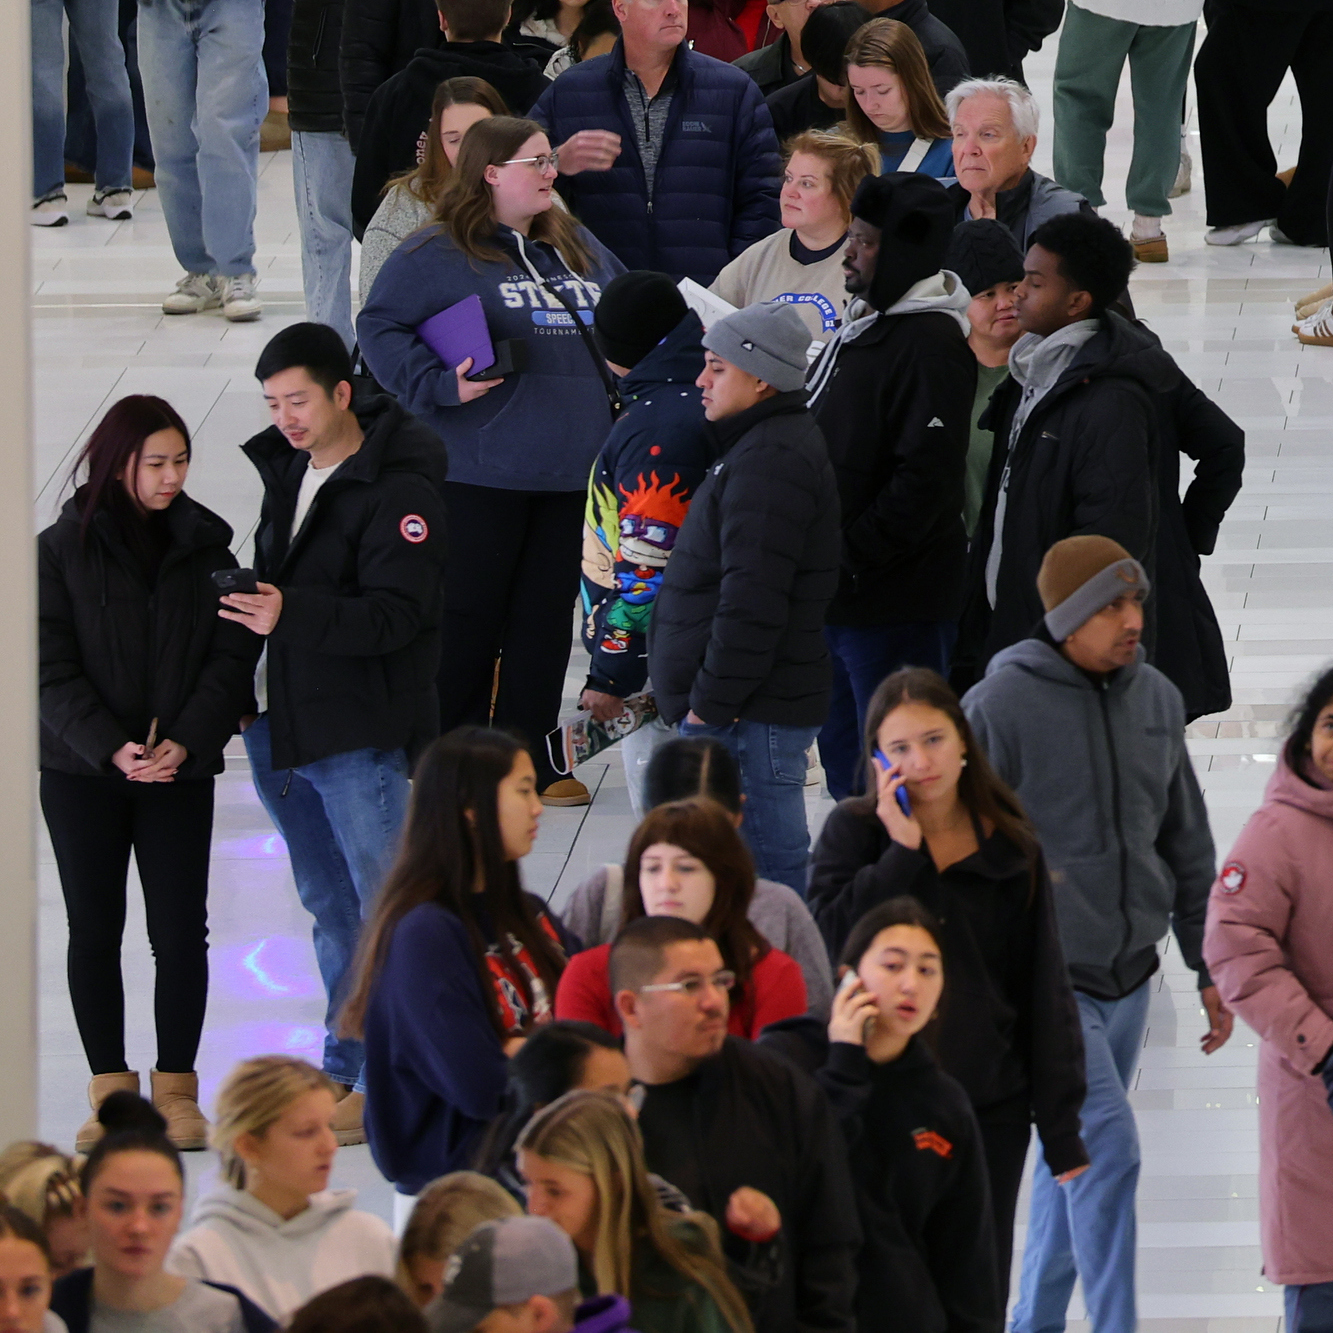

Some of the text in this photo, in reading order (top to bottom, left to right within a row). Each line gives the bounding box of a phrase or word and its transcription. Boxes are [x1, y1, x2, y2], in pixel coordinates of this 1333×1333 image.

[499, 280, 602, 308] STTE
[797, 295, 833, 315] COLEGE
[545, 313, 576, 324] SPEEC
[534, 327, 595, 335] TOURNAMT
